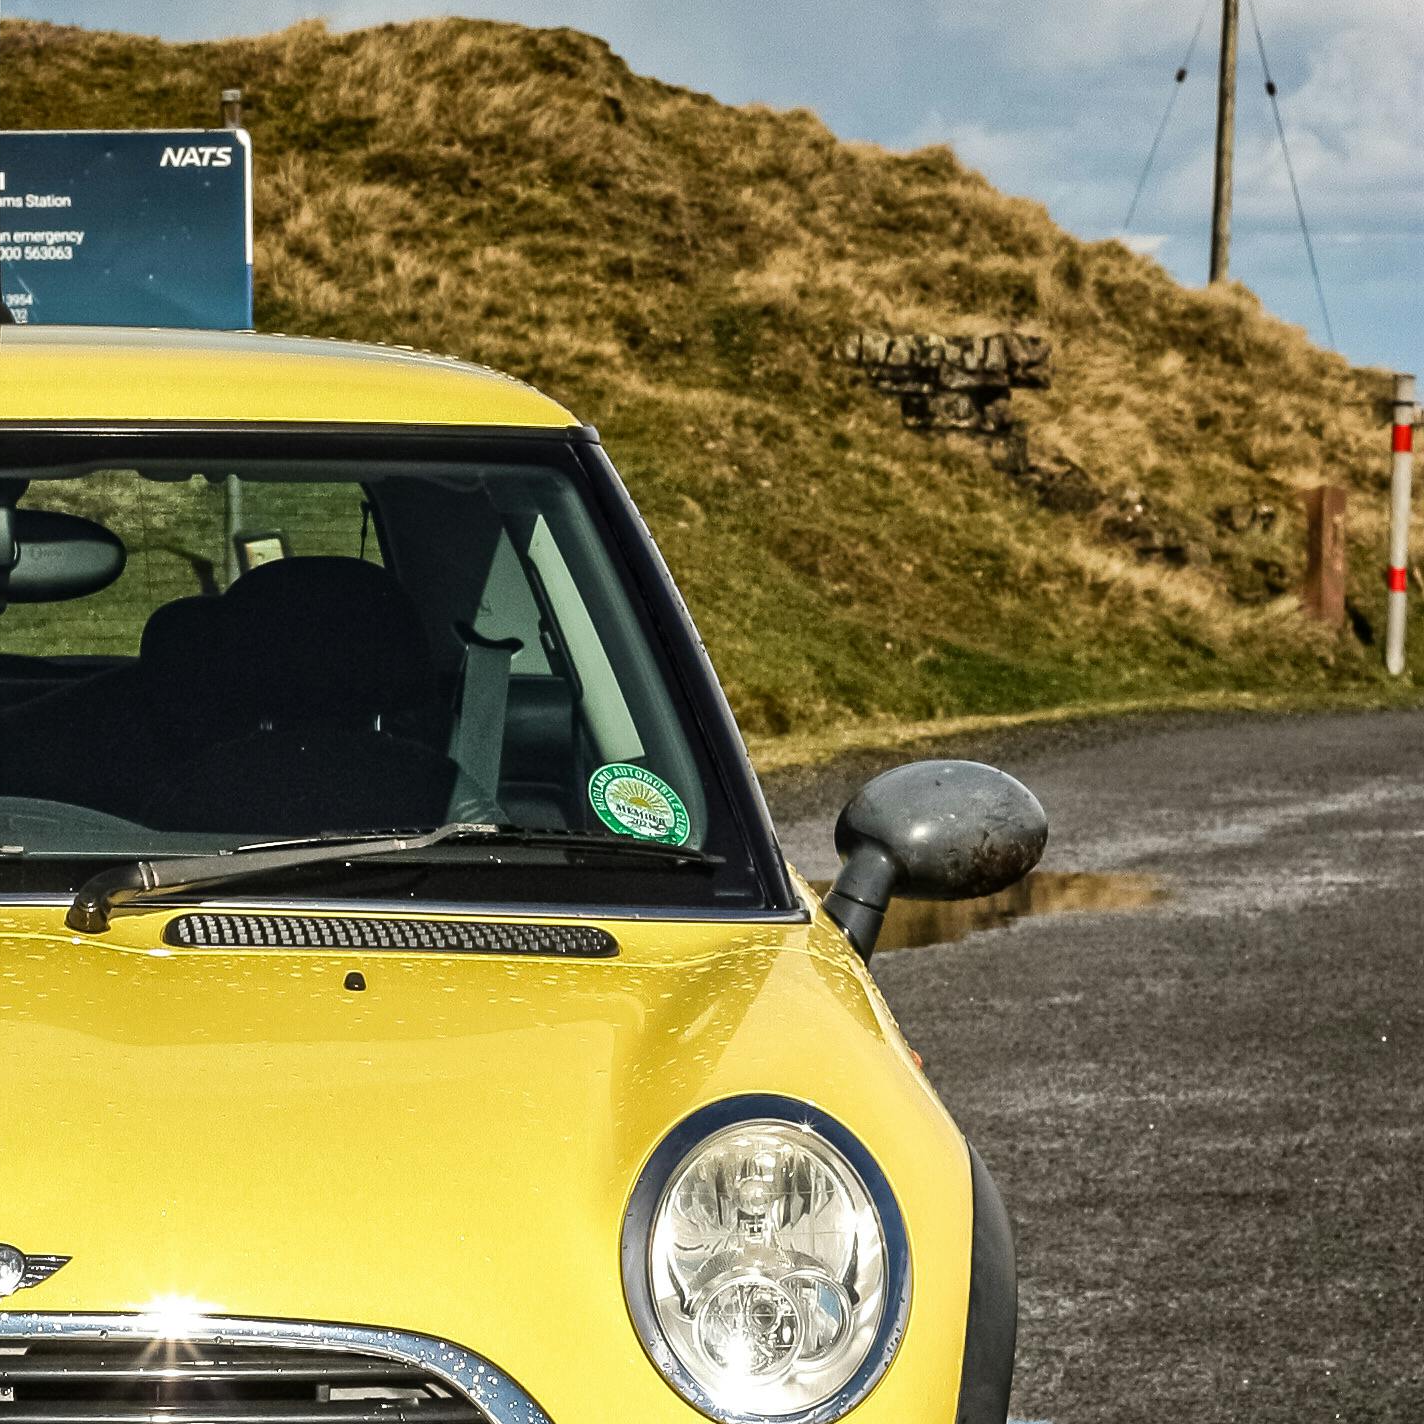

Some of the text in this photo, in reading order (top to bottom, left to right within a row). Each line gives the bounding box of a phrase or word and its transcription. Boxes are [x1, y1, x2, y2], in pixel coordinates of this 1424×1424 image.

[160, 147, 232, 167] NATS
[25, 194, 72, 208] Station
[13, 231, 85, 245] emergency
[24, 245, 73, 261] 563063
[593, 771, 613, 811] MIDLAND
[613, 767, 681, 809] AUTOMOBILE
